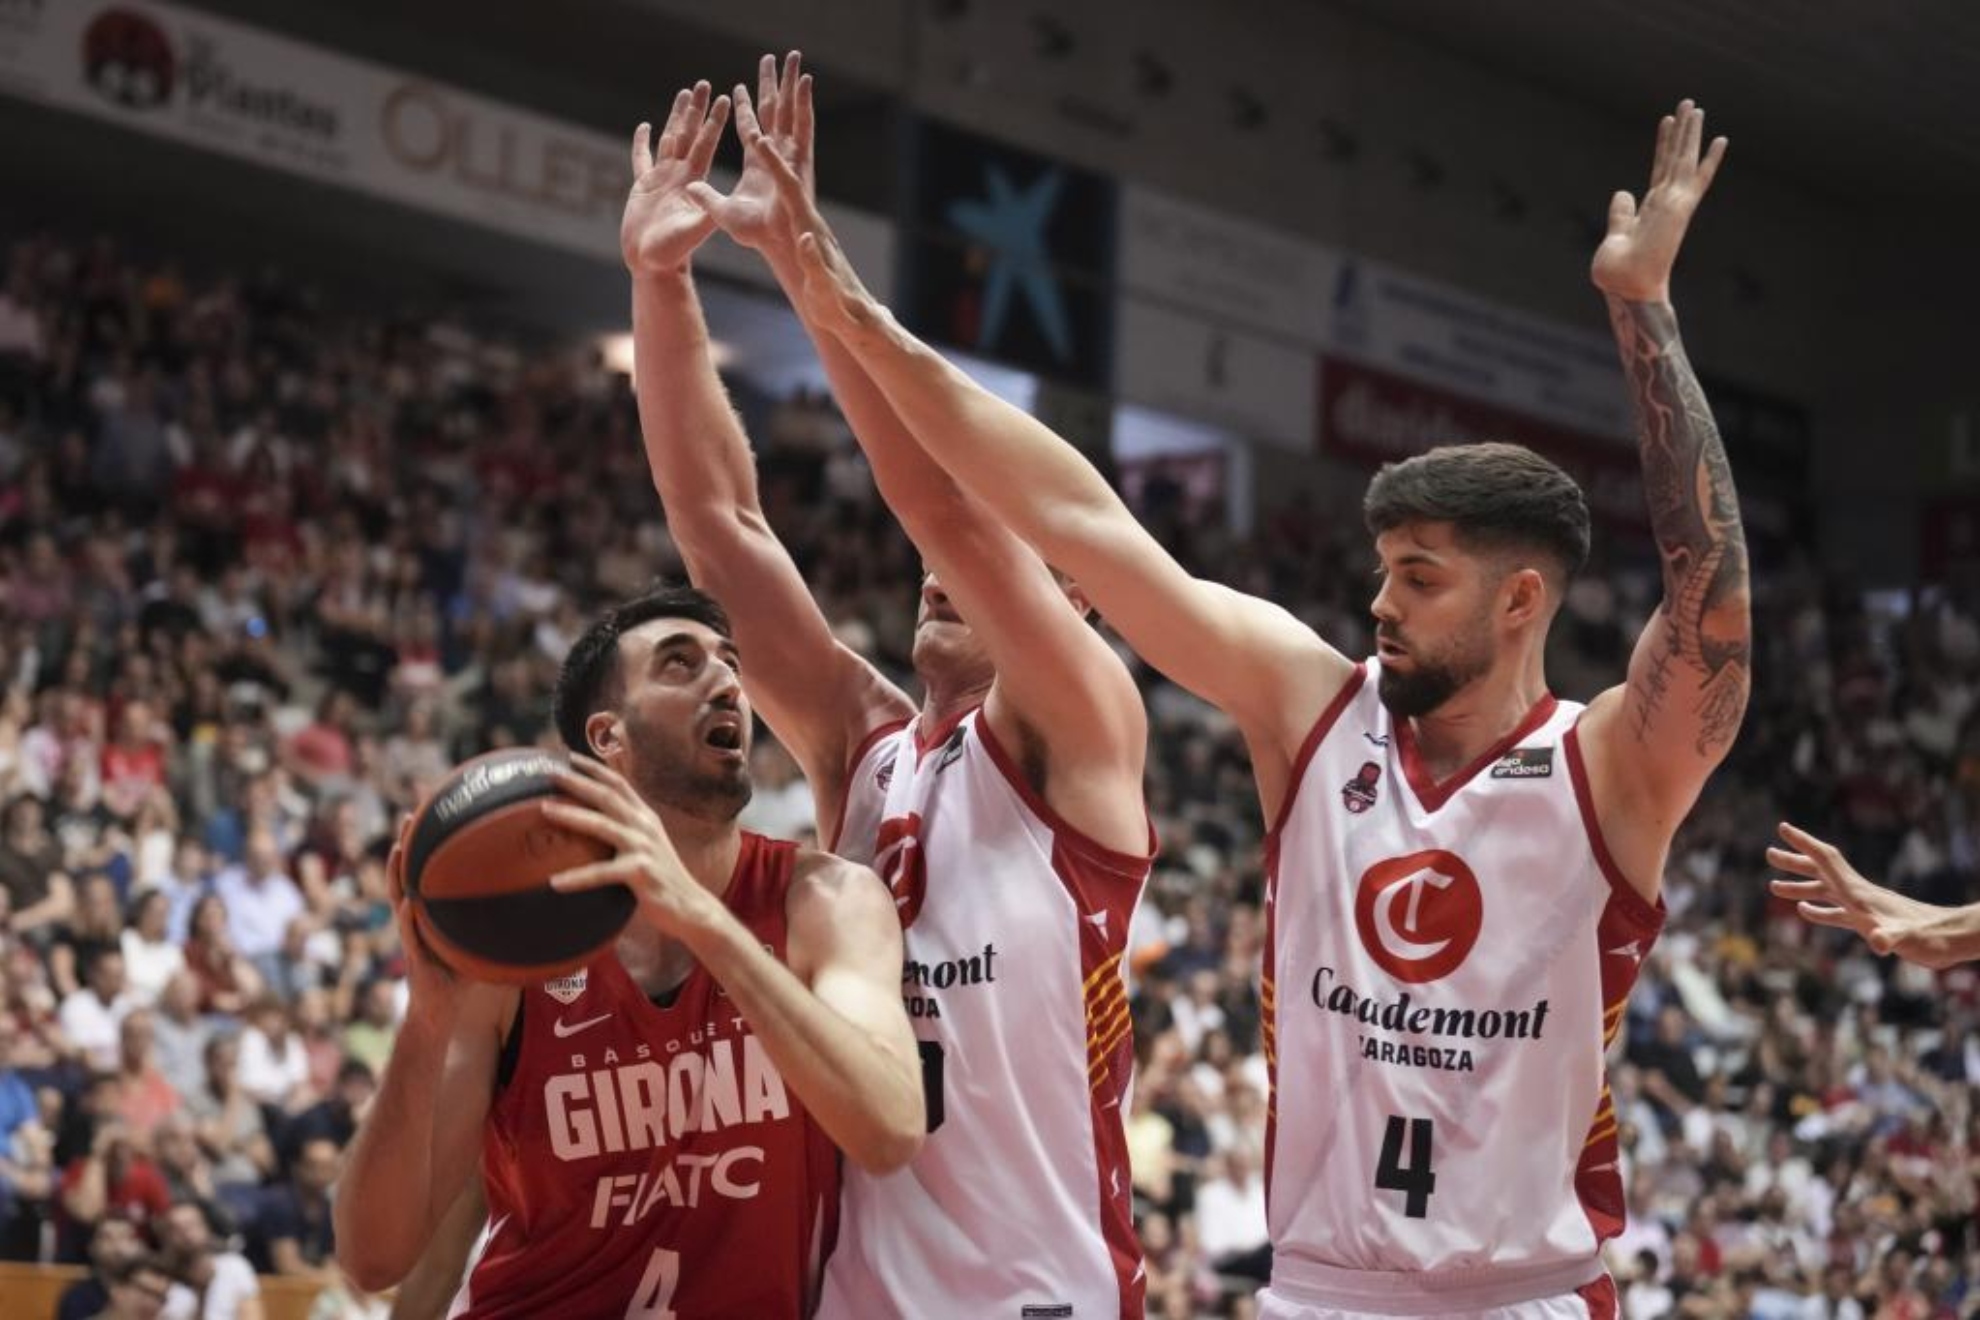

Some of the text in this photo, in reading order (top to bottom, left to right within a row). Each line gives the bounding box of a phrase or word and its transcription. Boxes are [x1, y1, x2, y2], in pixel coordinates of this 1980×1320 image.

[1312, 967, 1550, 1039] Caademont
[1359, 1035, 1474, 1072] ARAGOZA
[544, 1034, 790, 1162] GIRONA
[590, 1146, 765, 1229] FIATC
[1374, 1115, 1436, 1219] 4
[623, 1246, 680, 1320] 4
